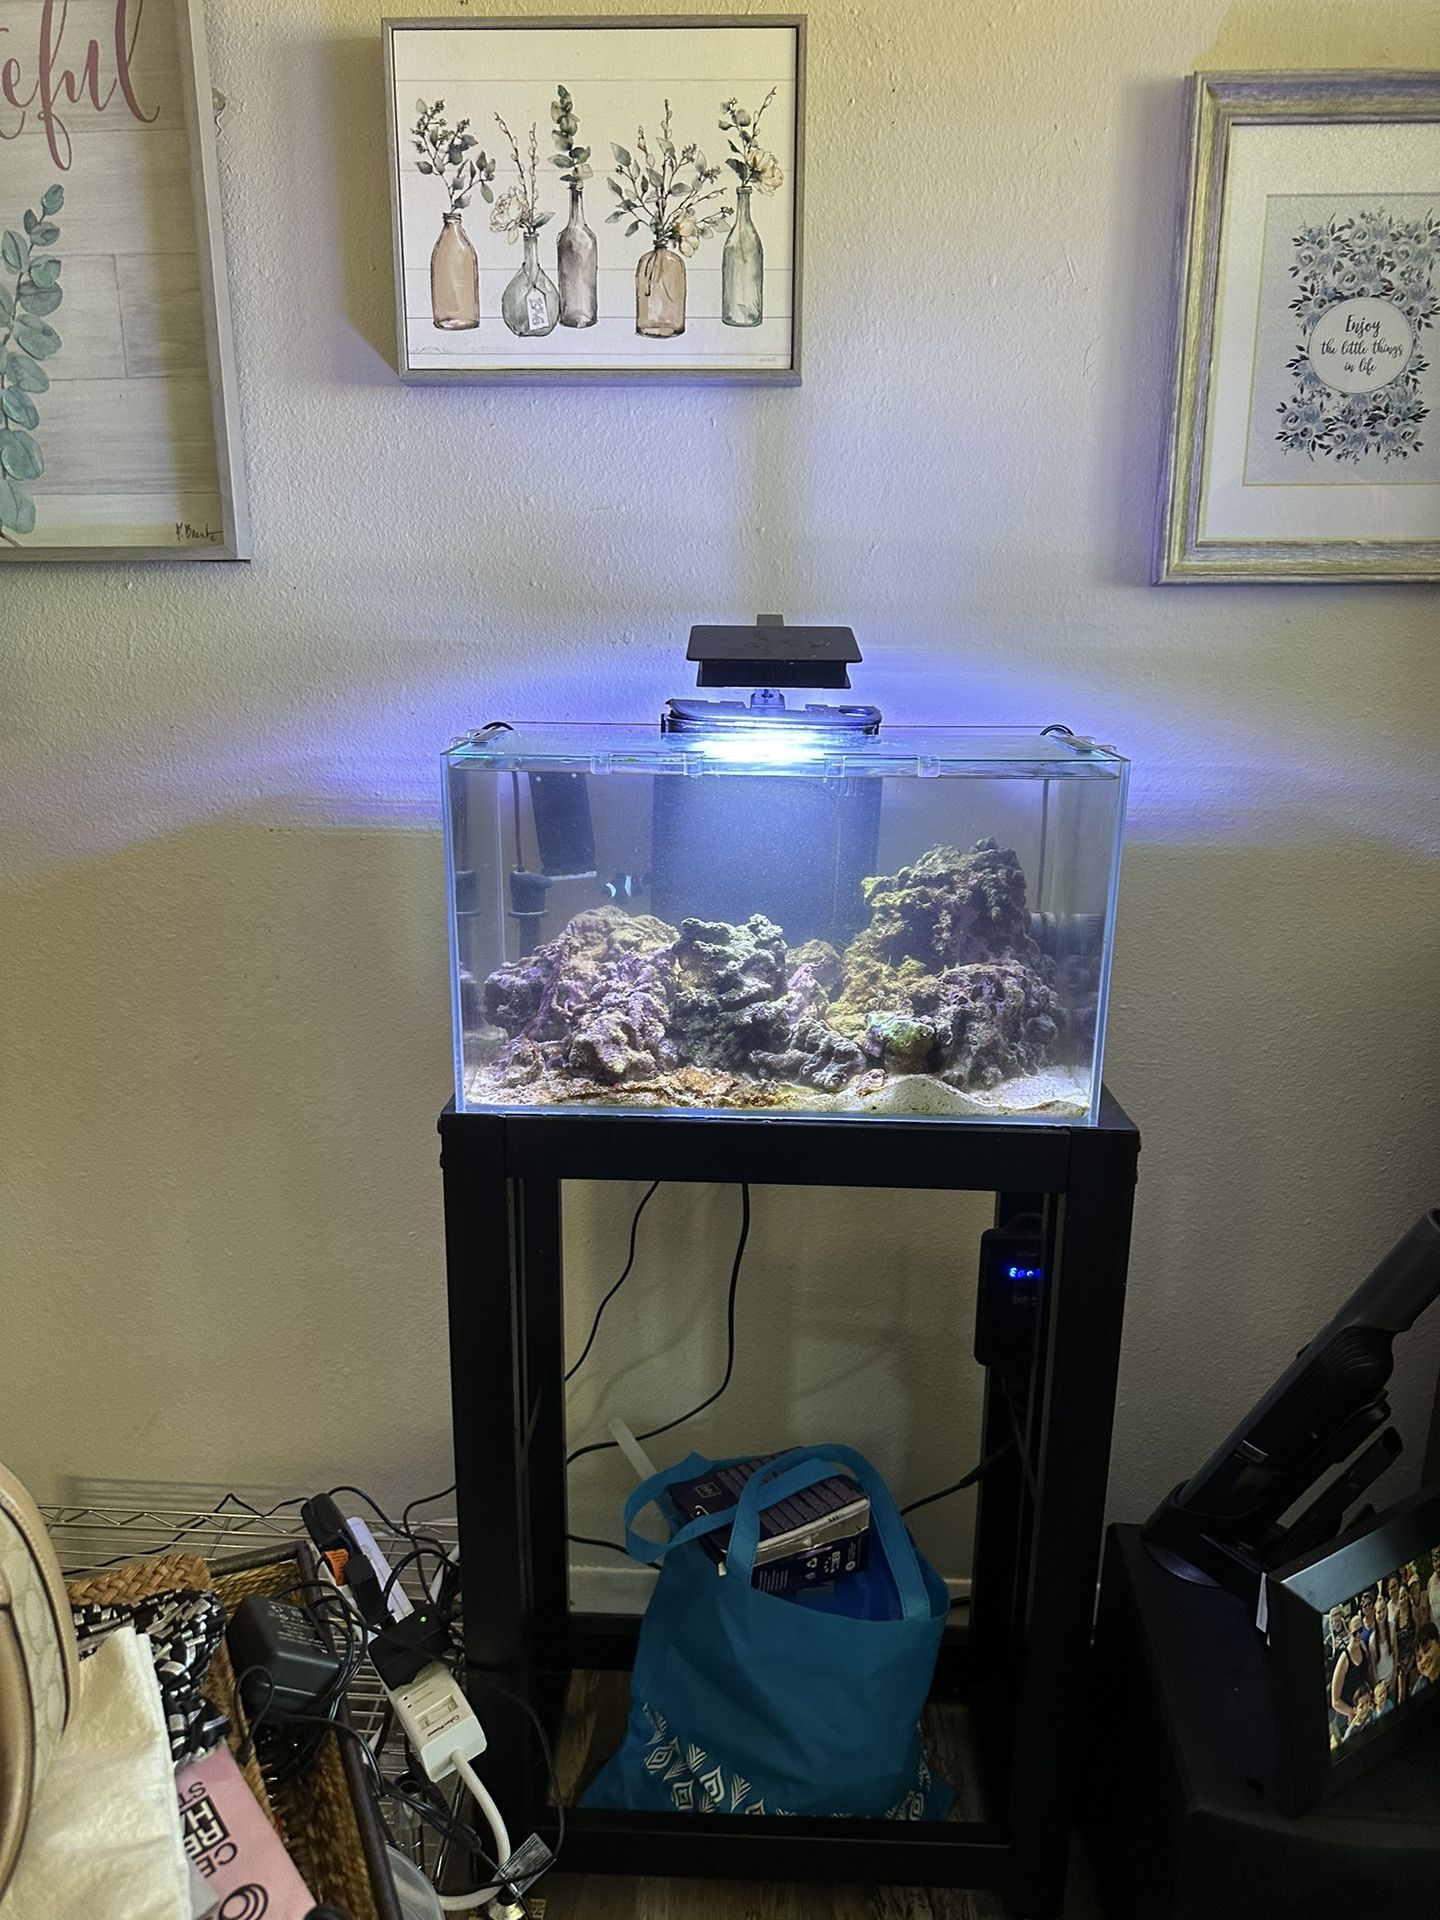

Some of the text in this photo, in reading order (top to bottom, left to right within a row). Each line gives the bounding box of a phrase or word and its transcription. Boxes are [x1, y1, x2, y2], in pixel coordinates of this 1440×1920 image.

[0, 0, 160, 171] eful
[1345, 314, 1381, 338] Enjoy
[1320, 338, 1403, 358] the little things
[1344, 357, 1376, 376] in life
